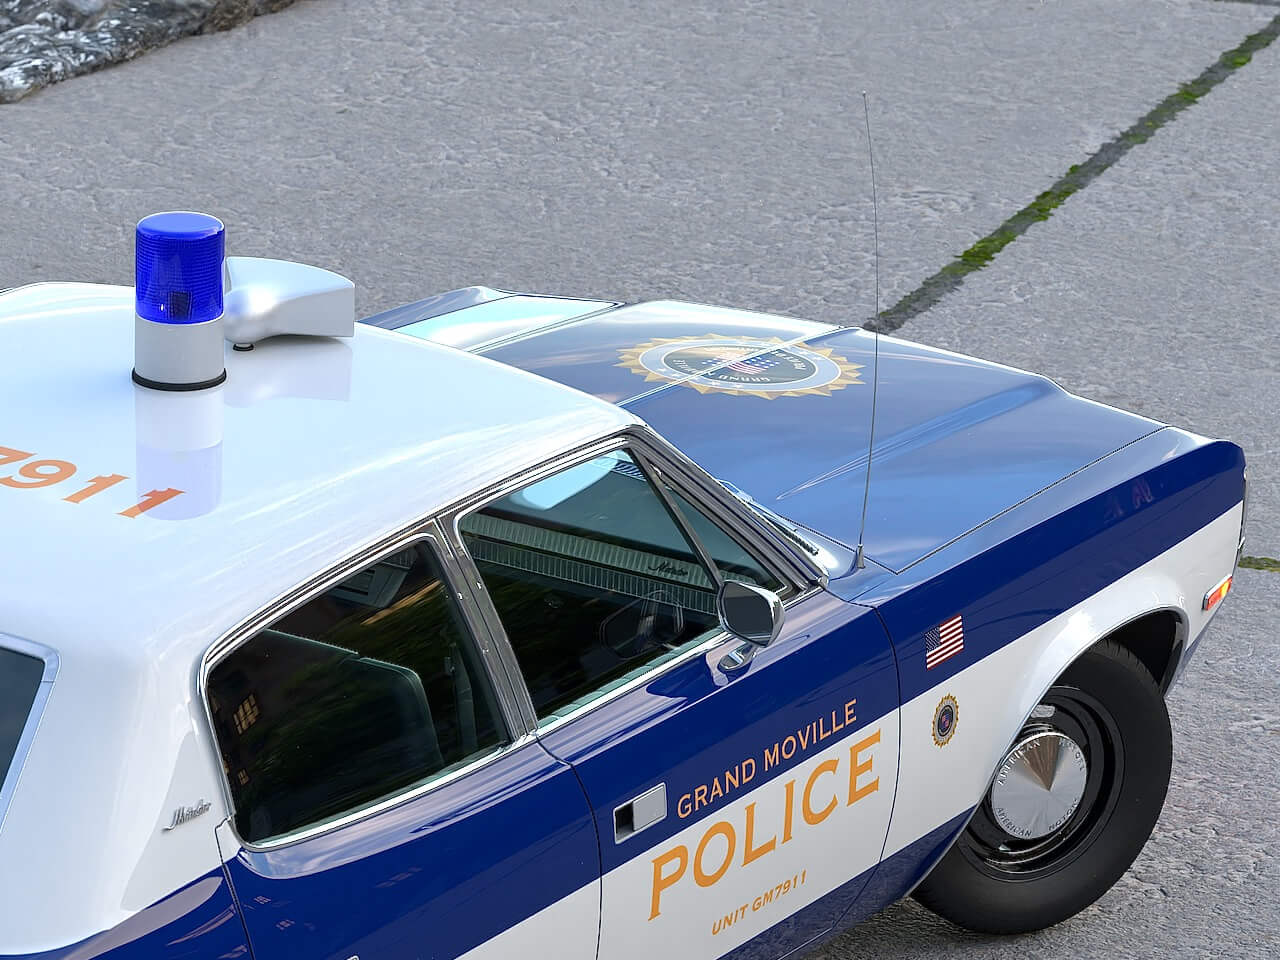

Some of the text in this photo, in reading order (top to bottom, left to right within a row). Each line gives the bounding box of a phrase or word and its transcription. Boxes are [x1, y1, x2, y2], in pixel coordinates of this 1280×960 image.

[677, 698, 858, 819] GRAND MOVILLE
[647, 727, 882, 922] POLICE
[711, 868, 807, 936] UNIT GM7911
